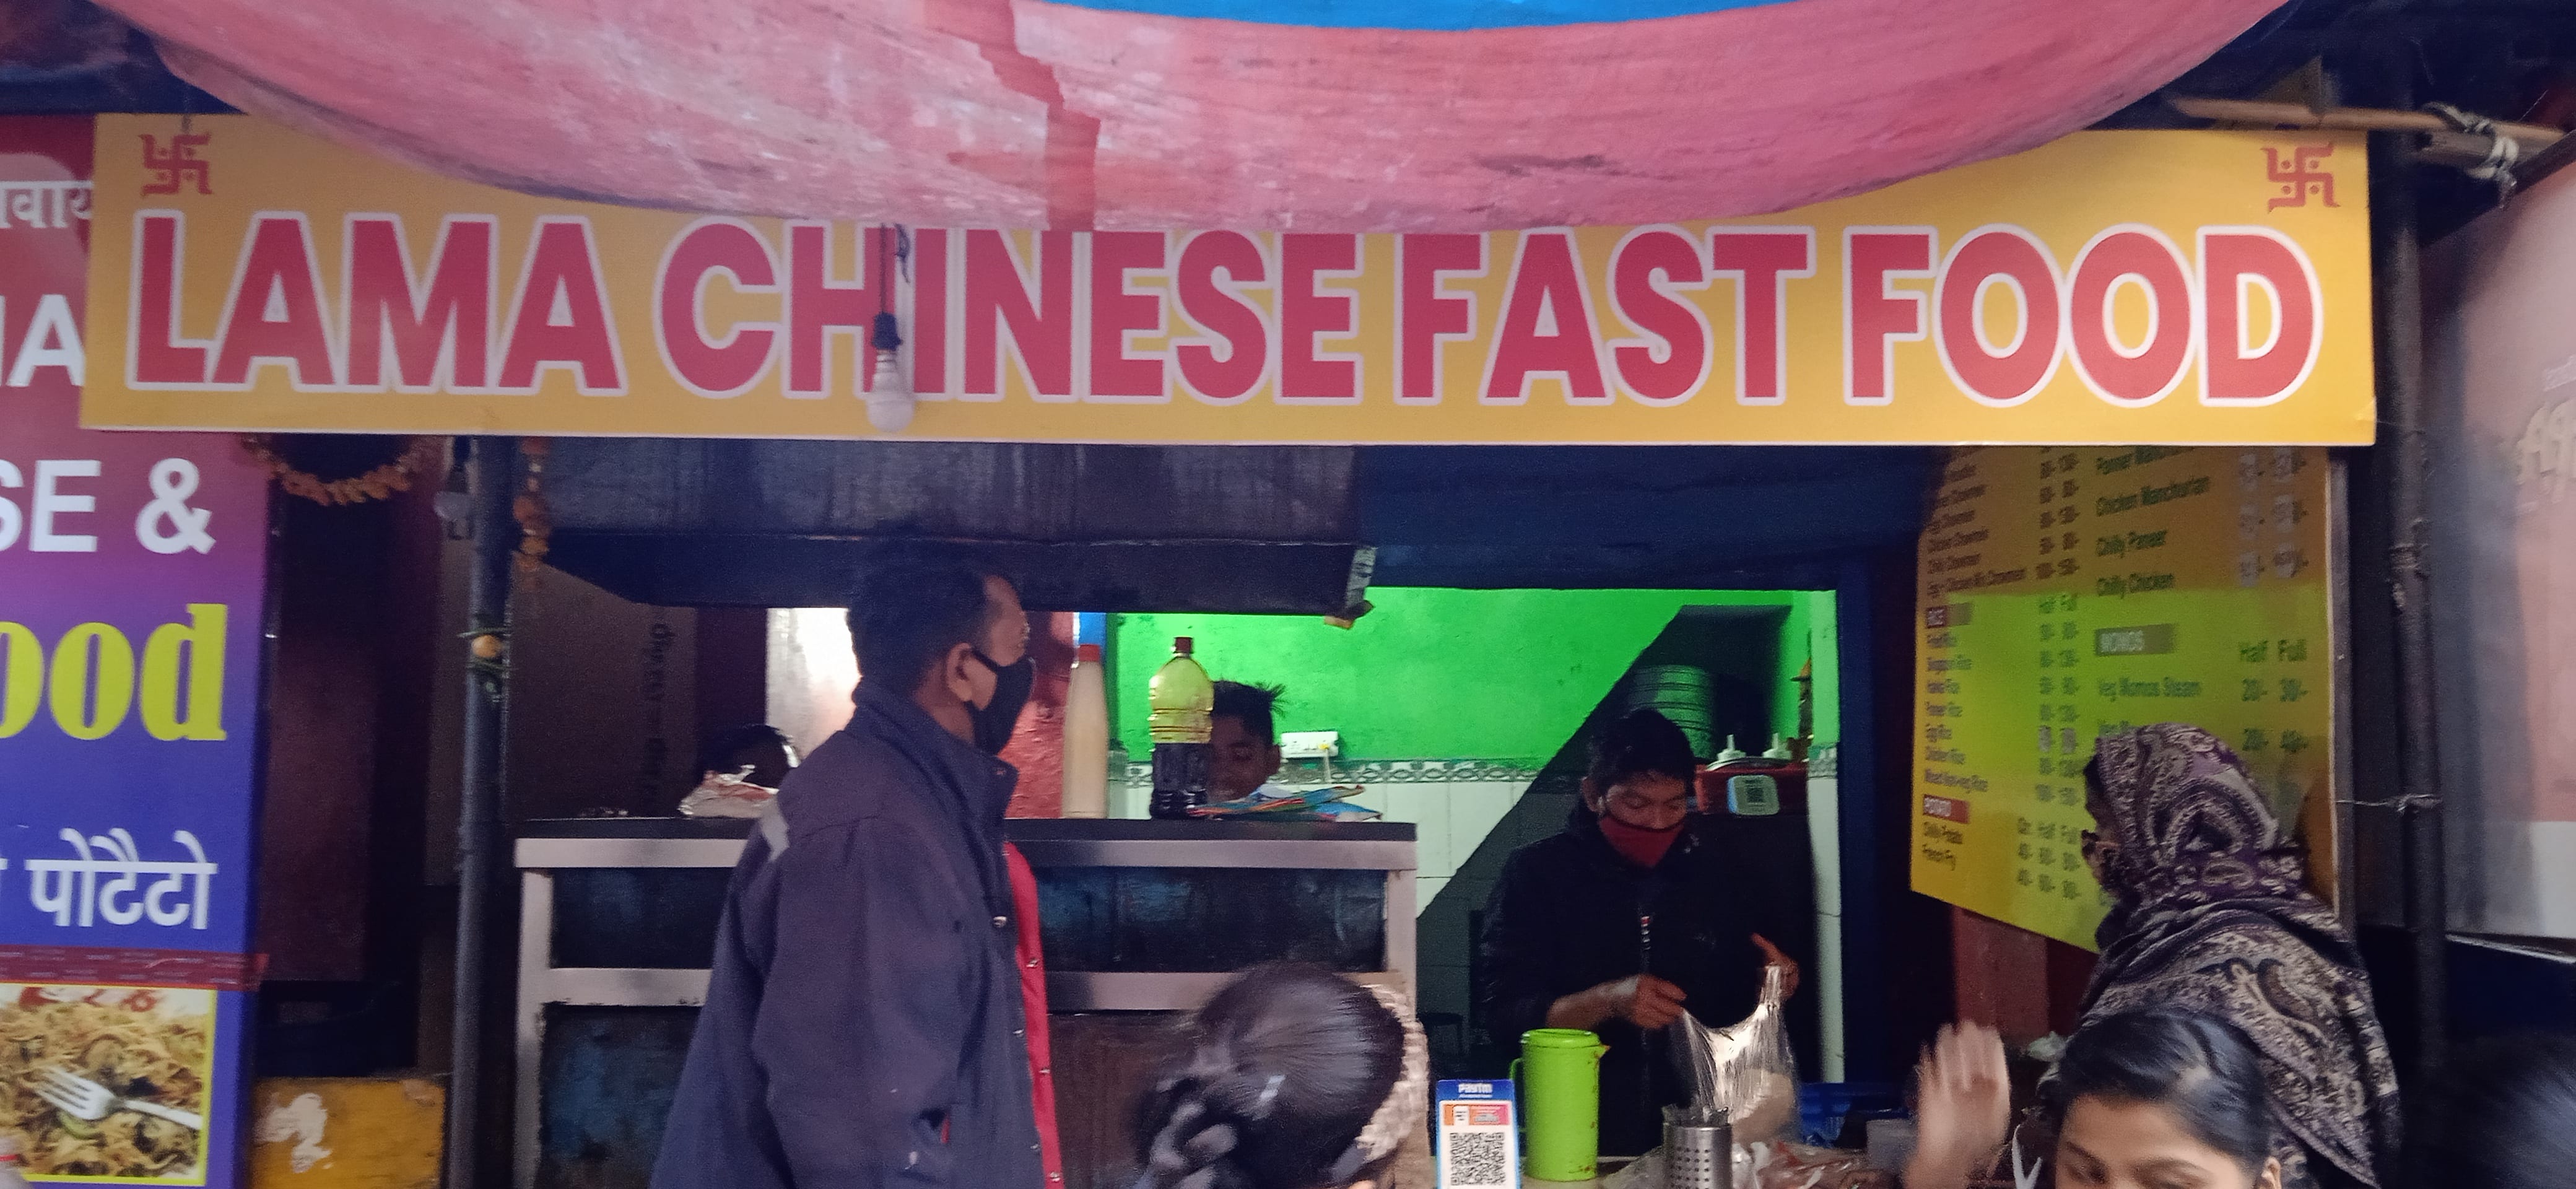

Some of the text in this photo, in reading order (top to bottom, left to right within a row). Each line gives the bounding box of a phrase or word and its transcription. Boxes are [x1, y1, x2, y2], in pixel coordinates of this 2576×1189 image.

[0, 294, 85, 387] A
[129, 211, 2323, 407] LAMA CHINESE FAST FOOD
[134, 457, 217, 554] &
[2239, 639, 2307, 662] Half Full
[25, 828, 218, 930] पोटैटो
